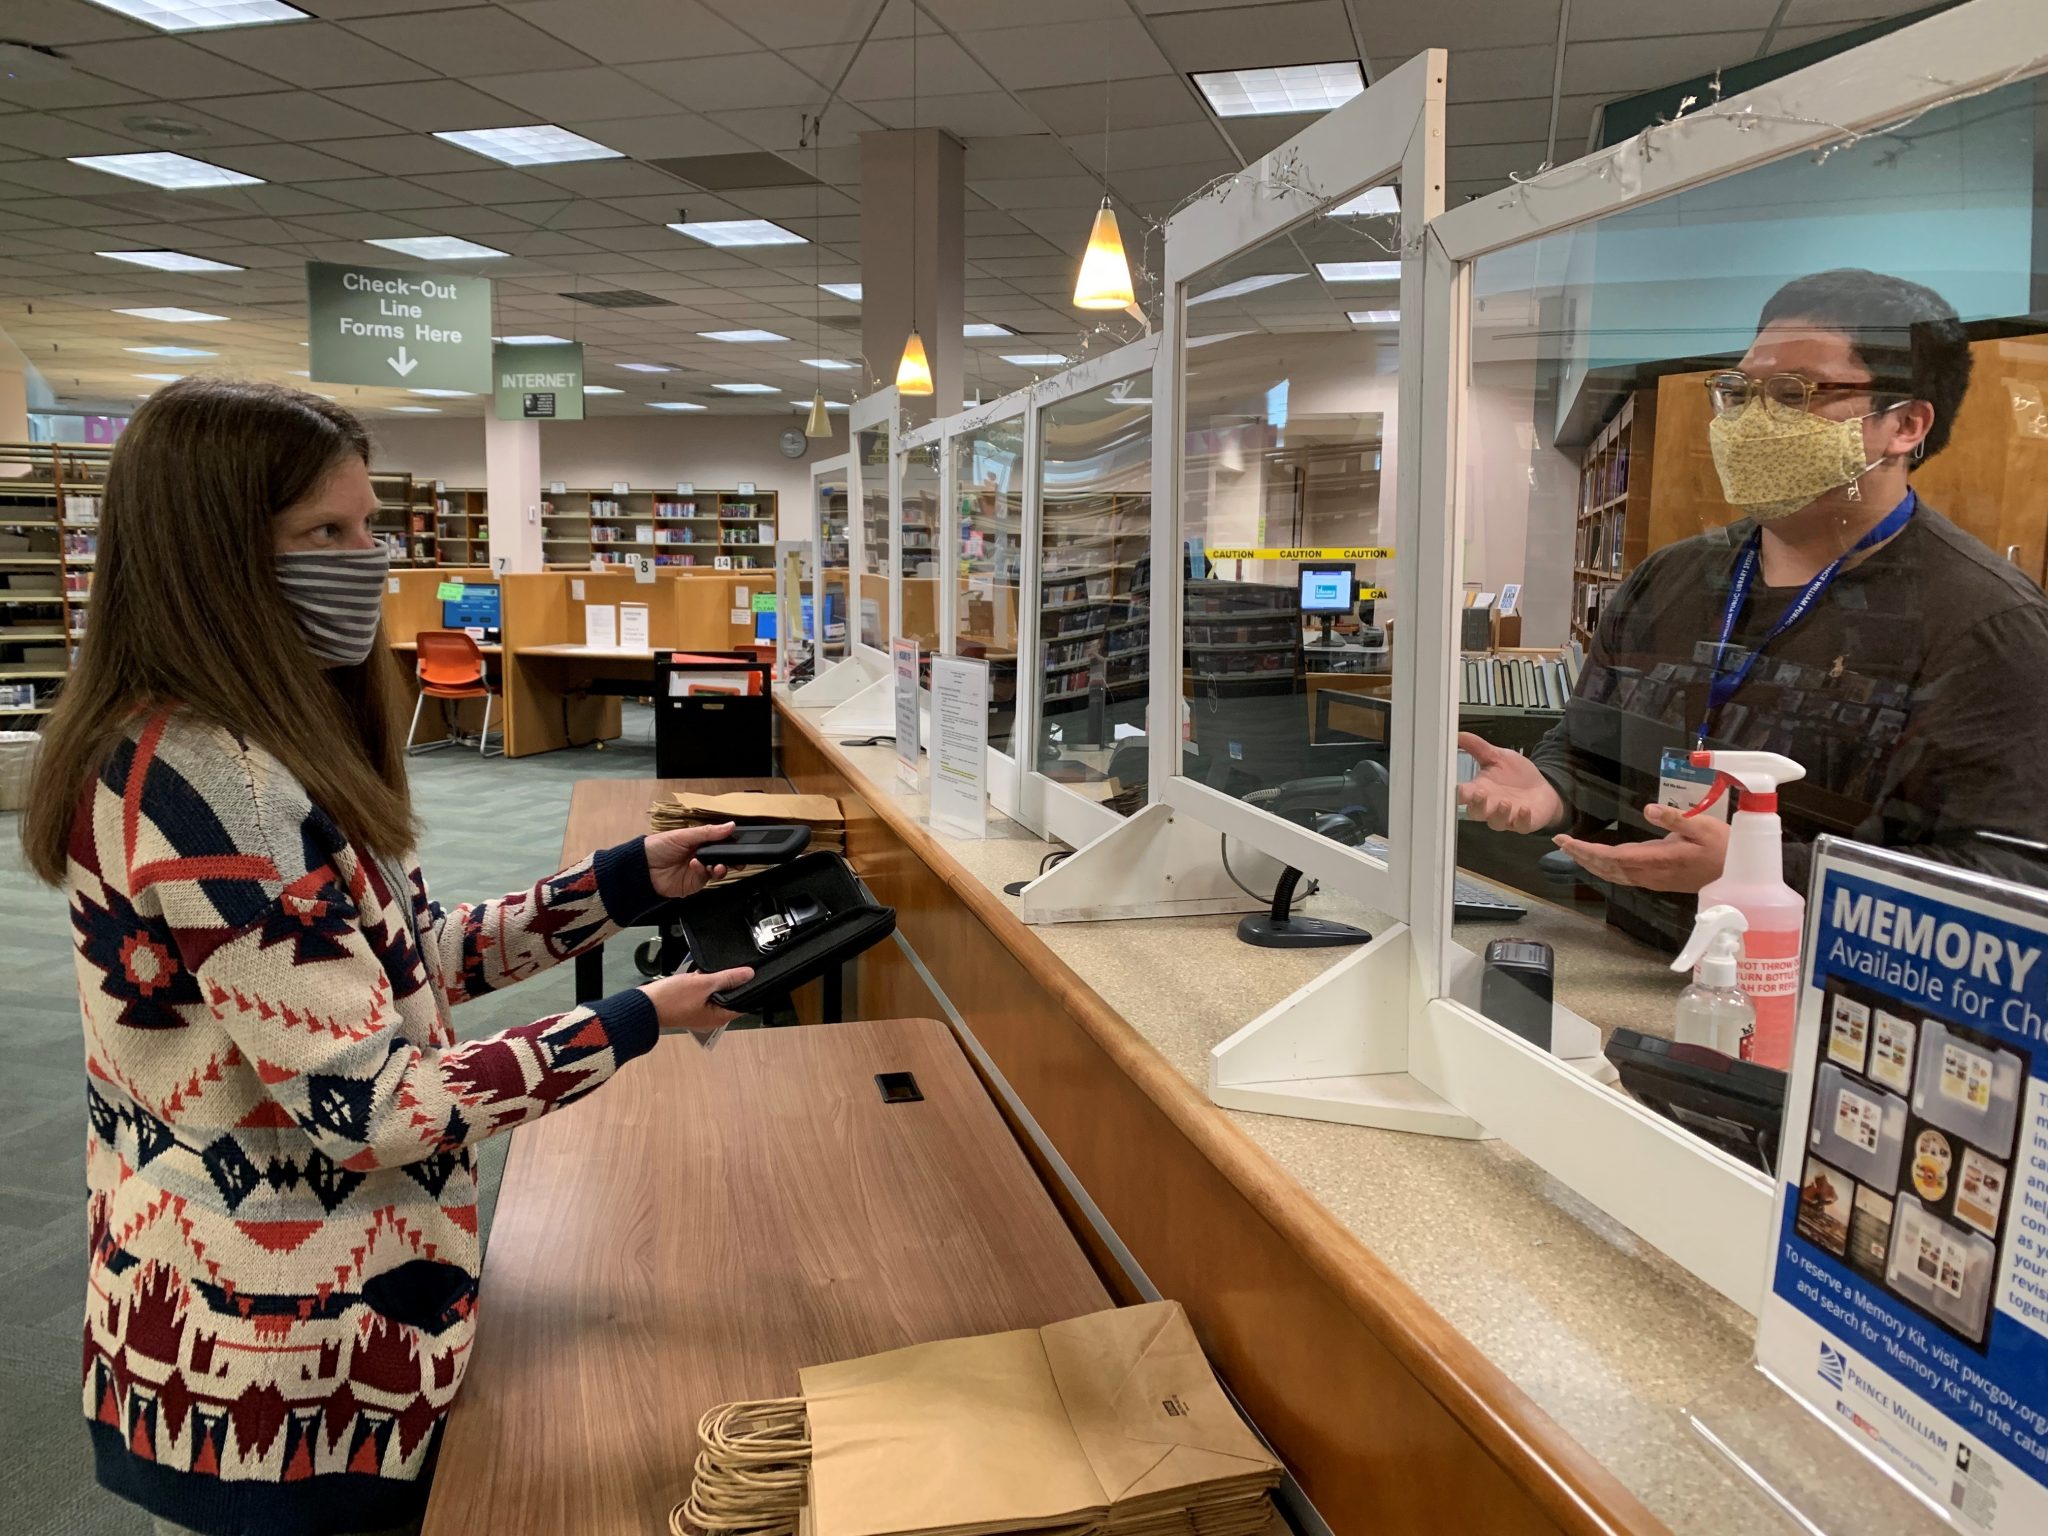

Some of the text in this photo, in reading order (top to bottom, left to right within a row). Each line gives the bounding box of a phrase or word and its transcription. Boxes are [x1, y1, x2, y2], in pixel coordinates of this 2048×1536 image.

[342, 272, 457, 299] Check-Out
[380, 299, 422, 318] Line
[340, 317, 463, 344] Forms Here
[502, 373, 576, 388] INTERNET
[717, 558, 729, 567] 14
[1213, 550, 1388, 558] CAUTION CAUTION CAUTION
[499, 558, 506, 570] 7
[640, 560, 649, 573] 8
[1736, 567, 1748, 592] LIBRARY
[1370, 591, 1388, 599] CA
[1800, 581, 1822, 606] WILLIAM
[1832, 887, 2042, 993] MEMORY
[1762, 961, 1792, 970] THROW
[1829, 937, 1944, 1002] Available
[1952, 978, 1995, 1019] for
[1758, 984, 1777, 992] FOR
[2040, 1092, 2048, 1107] T
[2034, 1132, 2048, 1151] in
[2031, 1155, 2048, 1173] ca
[2021, 1215, 2048, 1237] con
[2018, 1234, 2033, 1250] as
[2014, 1254, 2047, 1278] your
[1785, 1243, 1799, 1263] To
[1801, 1258, 1842, 1293] reserve
[1844, 1288, 1852, 1299] a
[1855, 1290, 1906, 1338] Memory
[1908, 1327, 1928, 1354] Kit,
[1932, 1345, 1960, 1373] visit
[1797, 1280, 1819, 1301] and
[1821, 1295, 1859, 1330] search
[1861, 1321, 1880, 1343] for
[1970, 1396, 1984, 1417] in
[1987, 1409, 2011, 1437] the
[1848, 1368, 1888, 1408] PRINCE
[1893, 1400, 1948, 1452] WILLIAM
